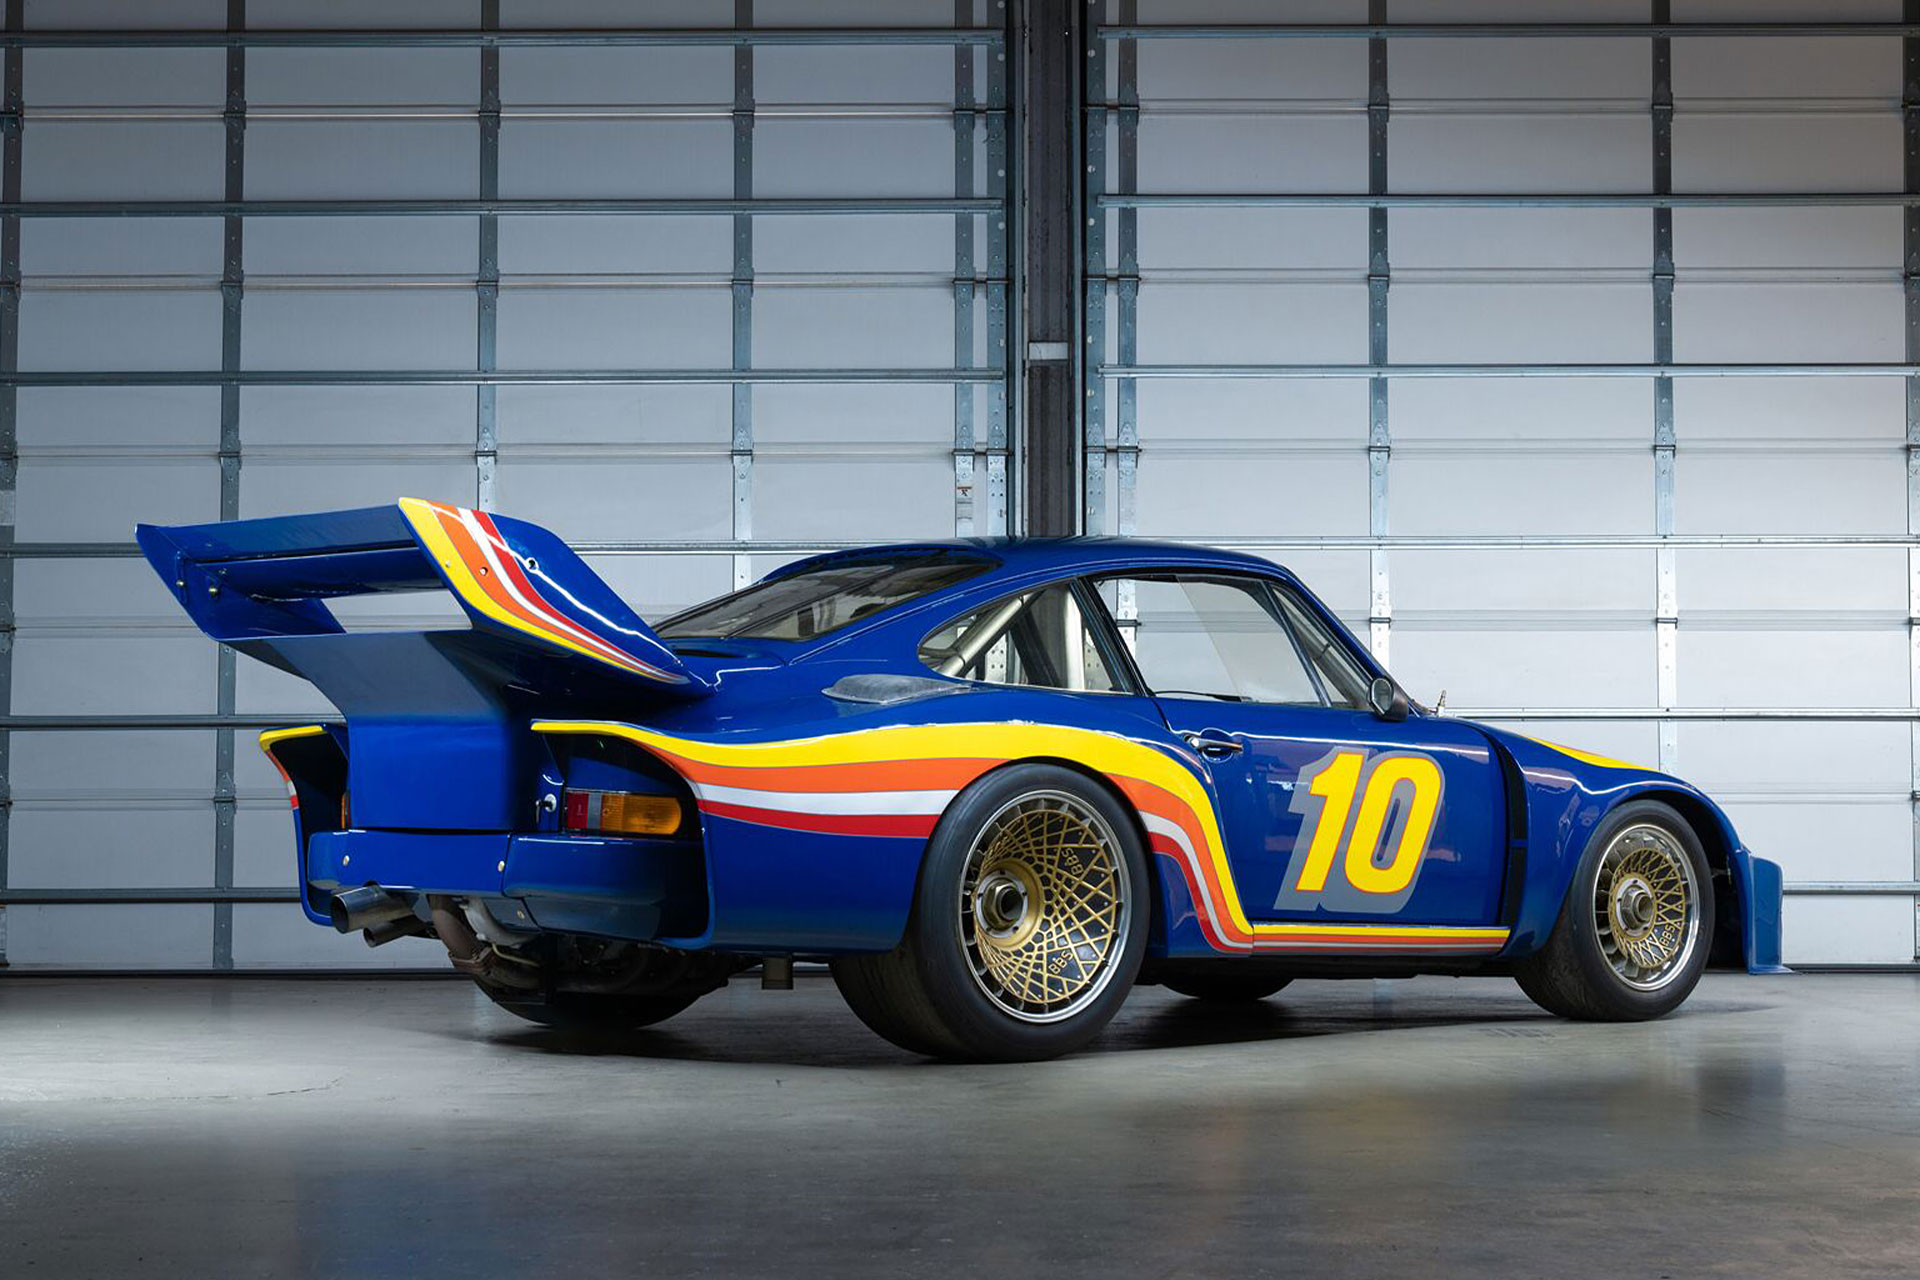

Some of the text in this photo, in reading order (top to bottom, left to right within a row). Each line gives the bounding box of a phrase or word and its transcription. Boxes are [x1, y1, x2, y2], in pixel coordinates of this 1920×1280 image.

[1295, 752, 1442, 894] 10
[1061, 847, 1084, 876] BBS
[1660, 924, 1676, 947] BBS
[1048, 950, 1074, 975] BBS
